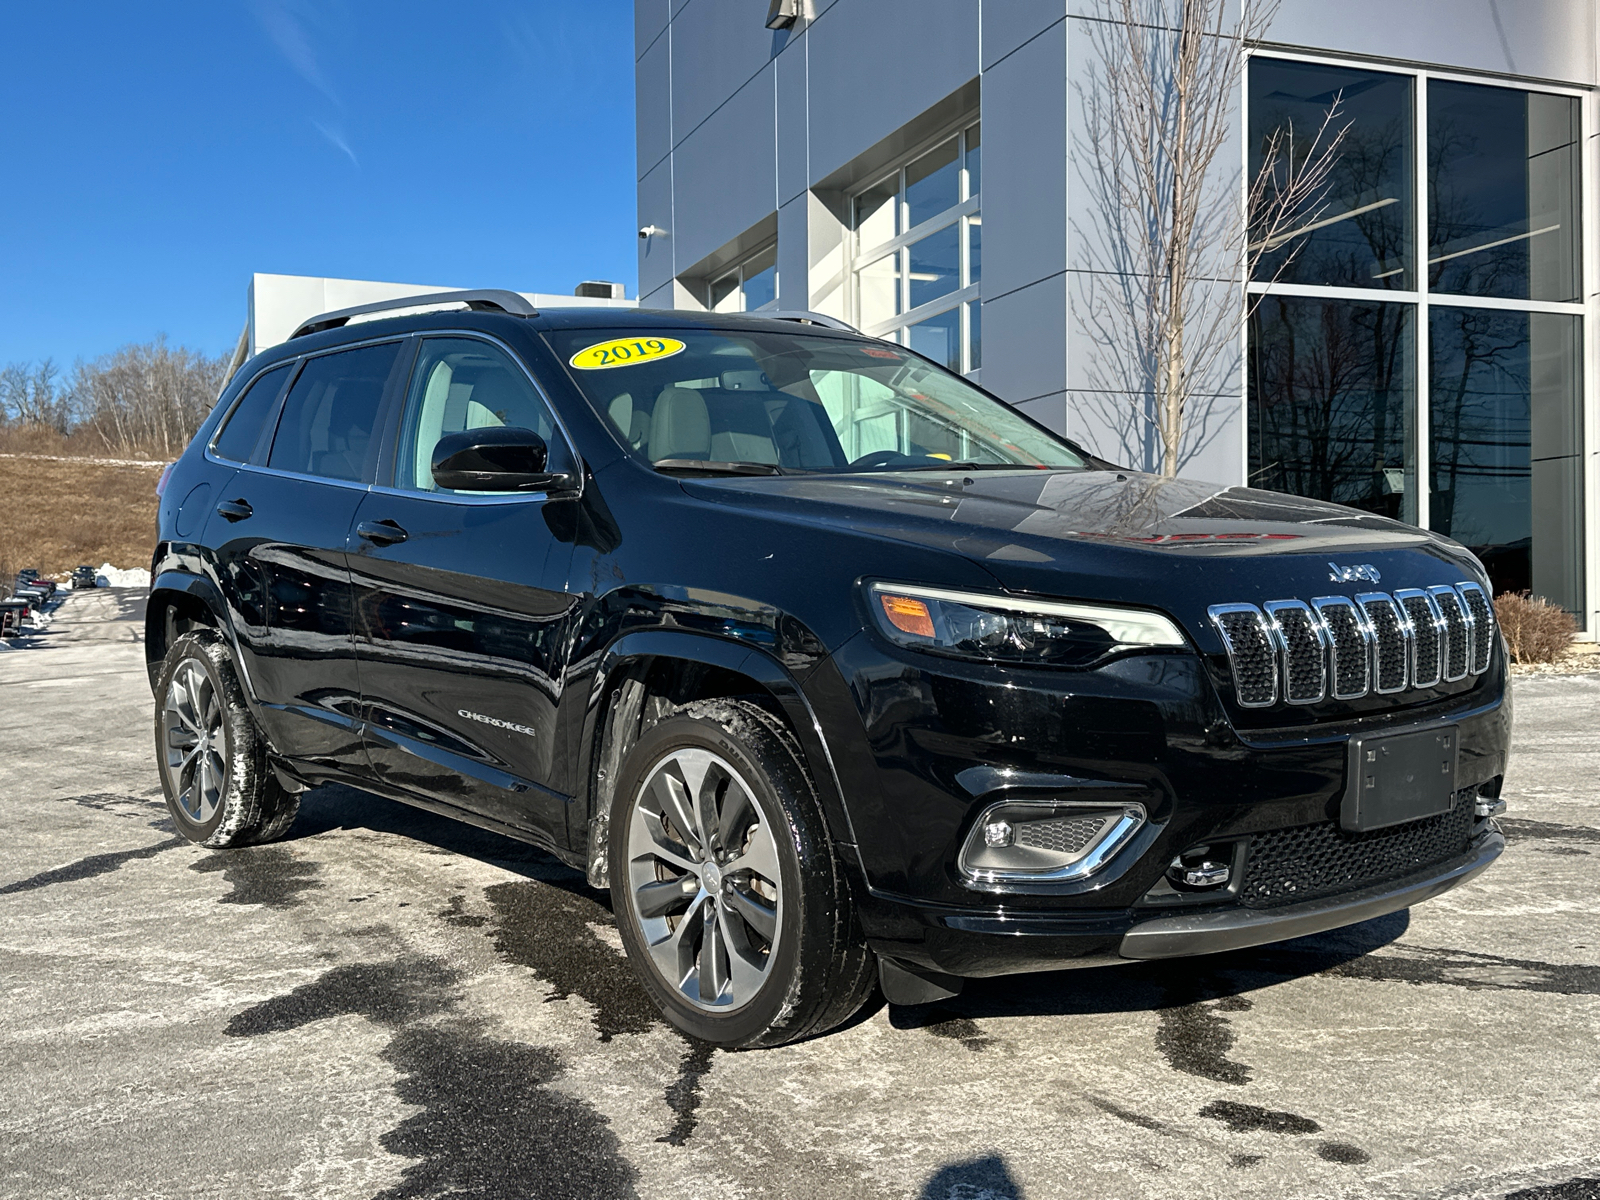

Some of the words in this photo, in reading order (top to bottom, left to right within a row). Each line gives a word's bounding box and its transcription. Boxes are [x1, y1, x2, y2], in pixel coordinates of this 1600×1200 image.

[593, 339, 666, 366] 2019
[1327, 561, 1381, 584] Jeep
[457, 709, 536, 737] CHEROKEE
